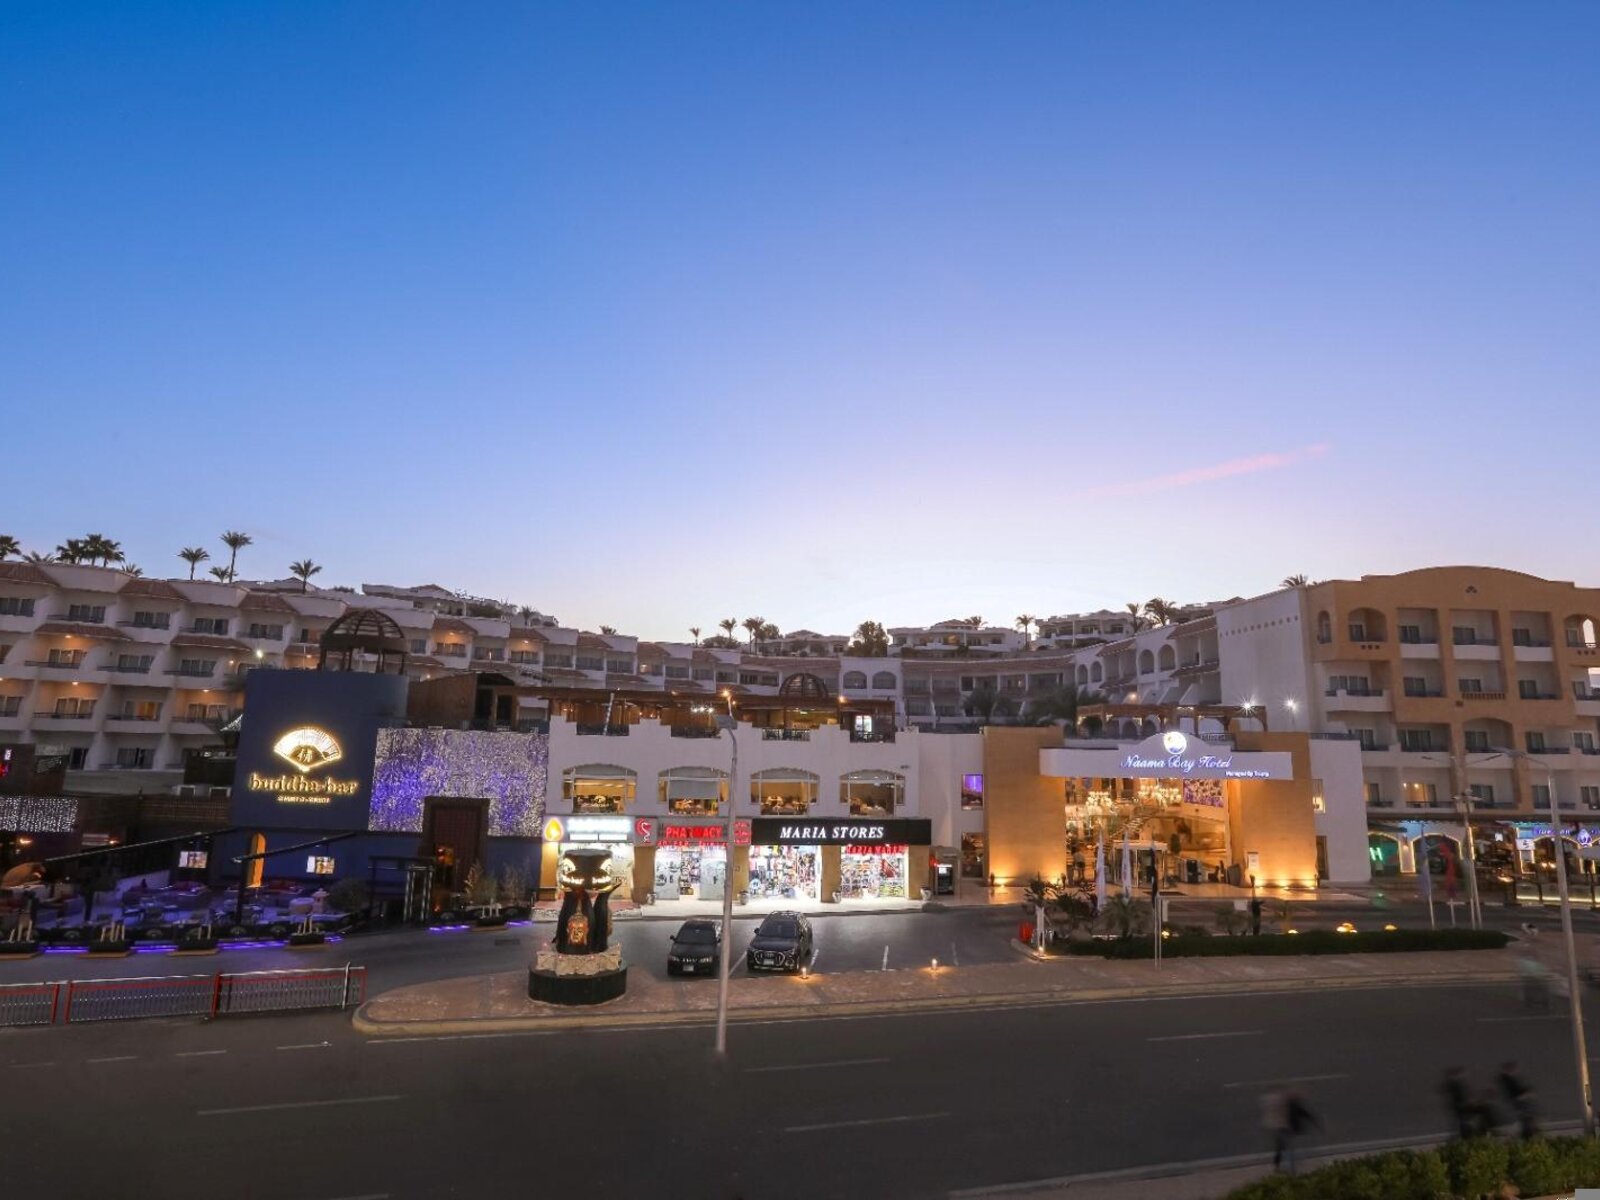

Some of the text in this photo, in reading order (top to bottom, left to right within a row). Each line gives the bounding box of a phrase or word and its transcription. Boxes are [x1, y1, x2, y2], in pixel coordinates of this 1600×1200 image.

[1121, 754, 1232, 773] Naama Bay Hotel
[780, 826, 884, 839] MARIA STORES
